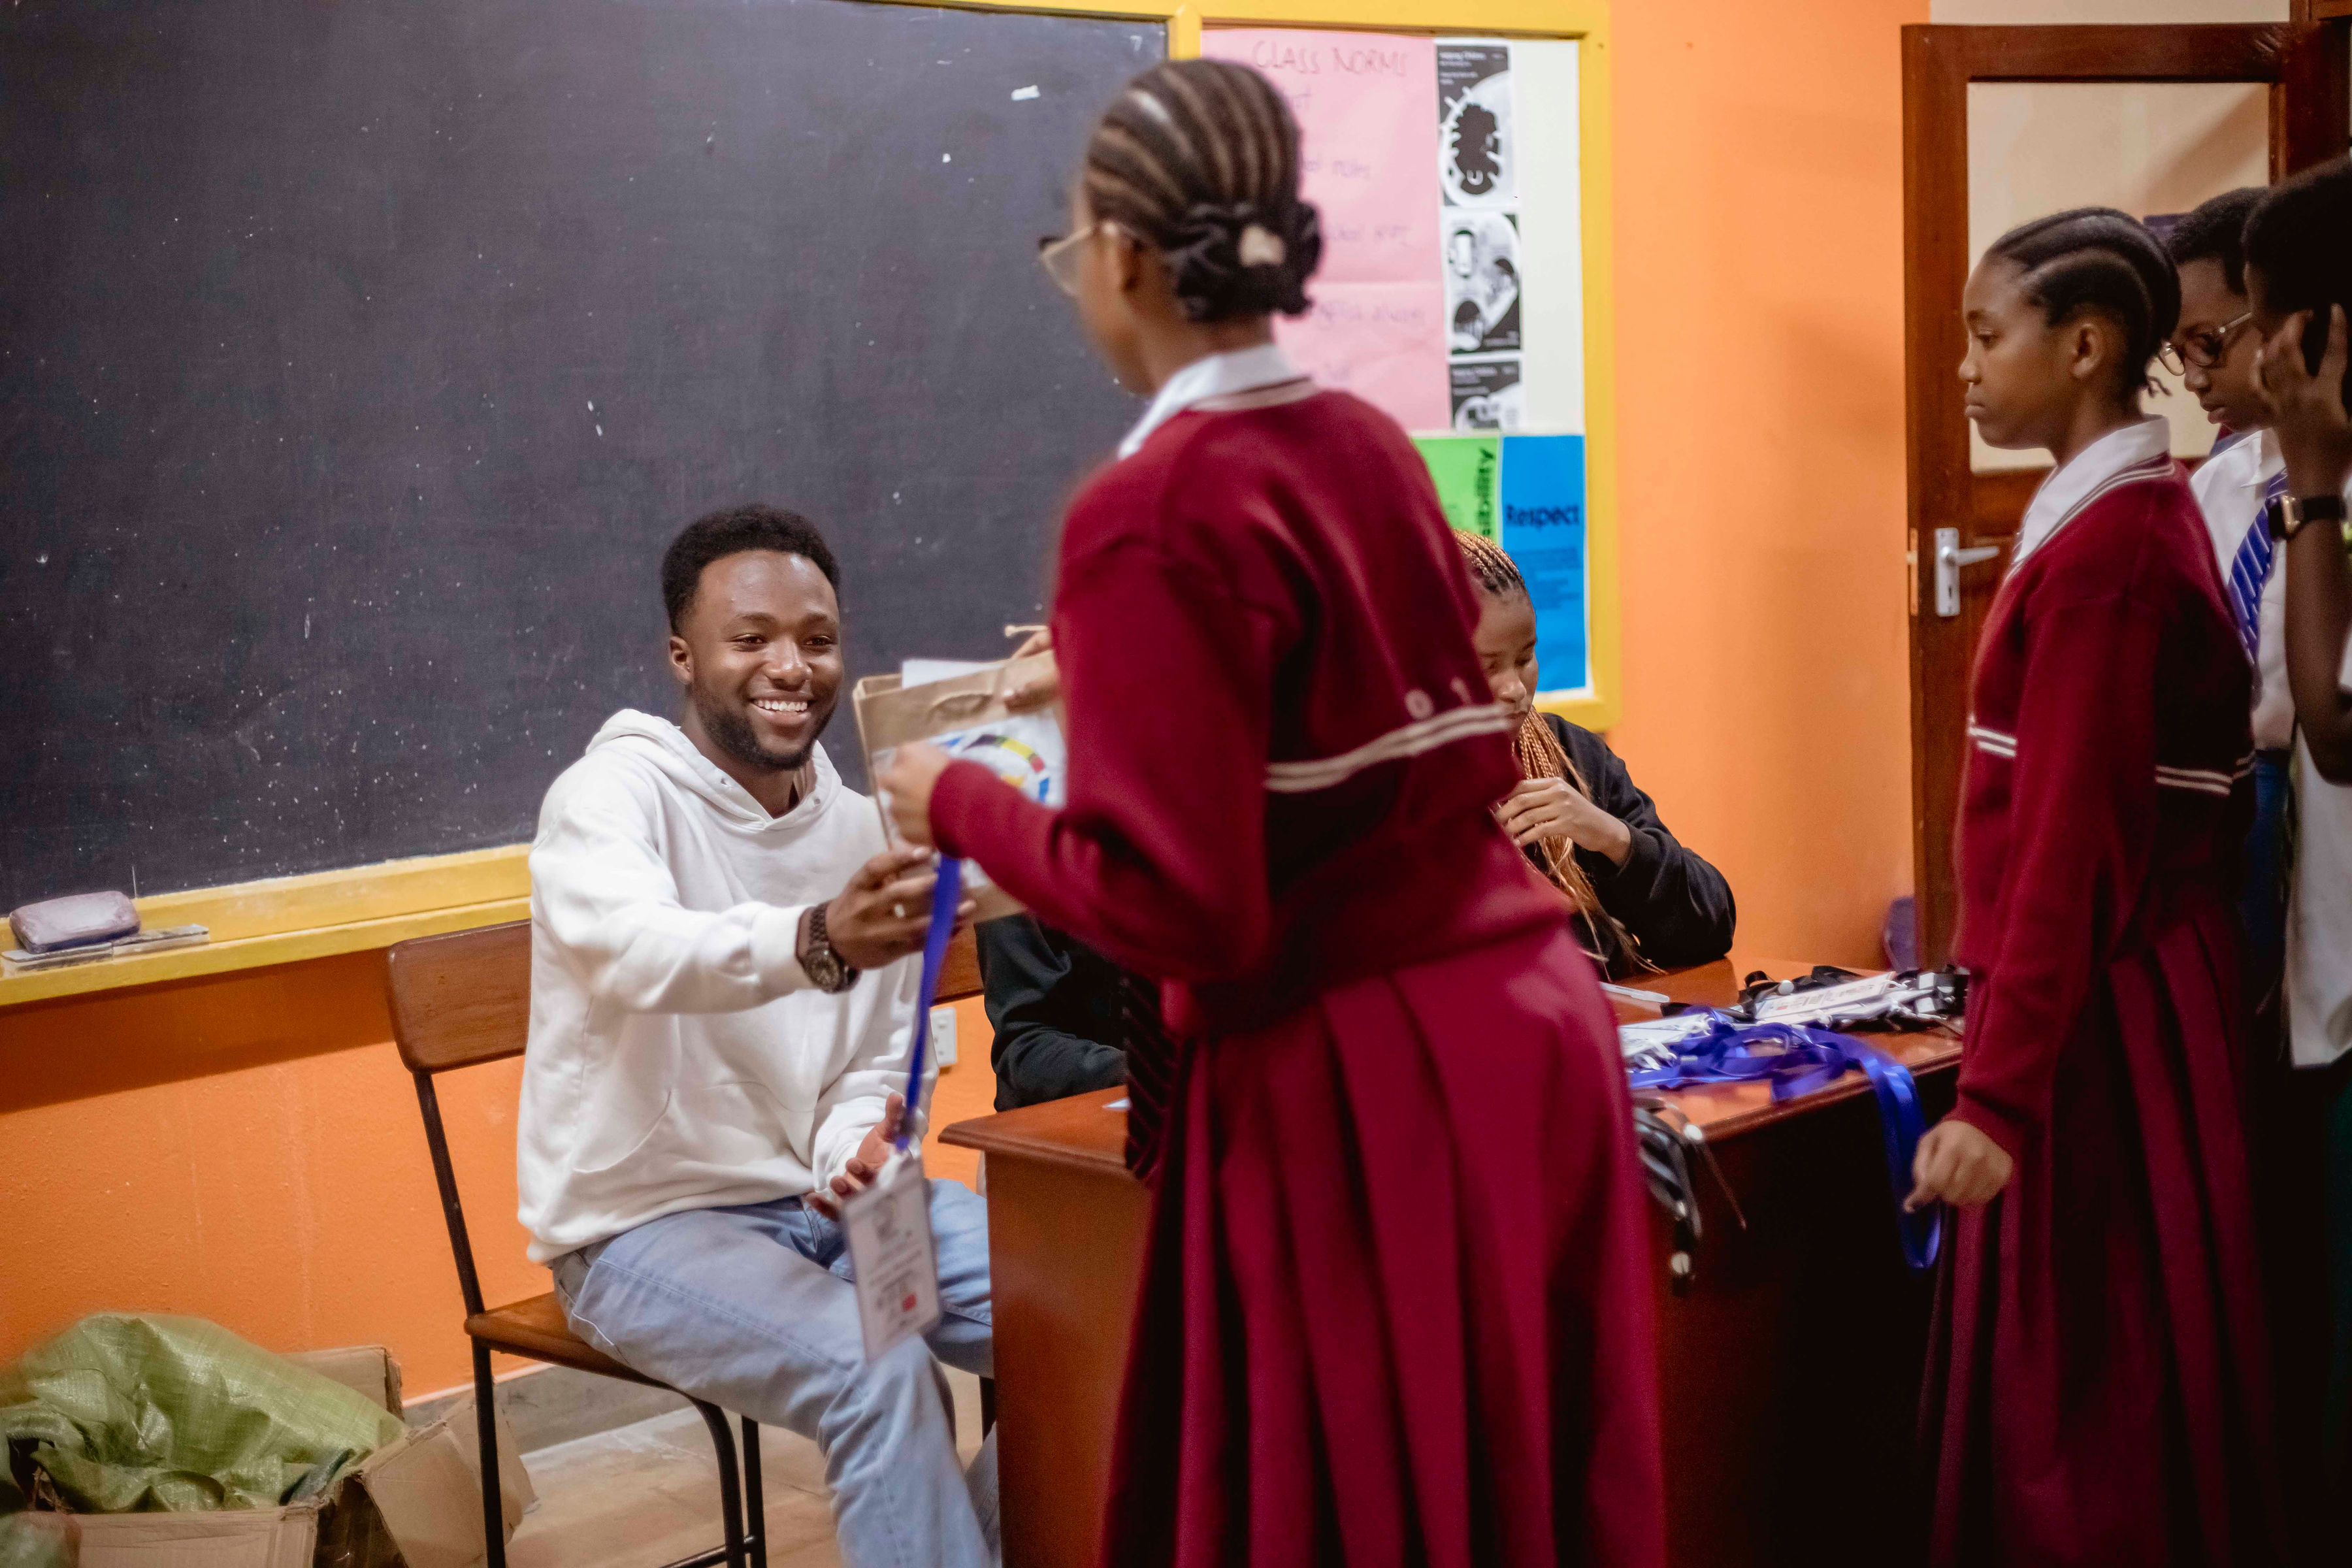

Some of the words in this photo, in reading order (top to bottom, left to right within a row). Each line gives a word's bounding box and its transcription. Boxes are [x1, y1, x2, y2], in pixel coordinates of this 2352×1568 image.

[1252, 40, 1321, 74] CLASS
[1332, 46, 1409, 78] NORMS
[1505, 503, 1580, 532] Respect
